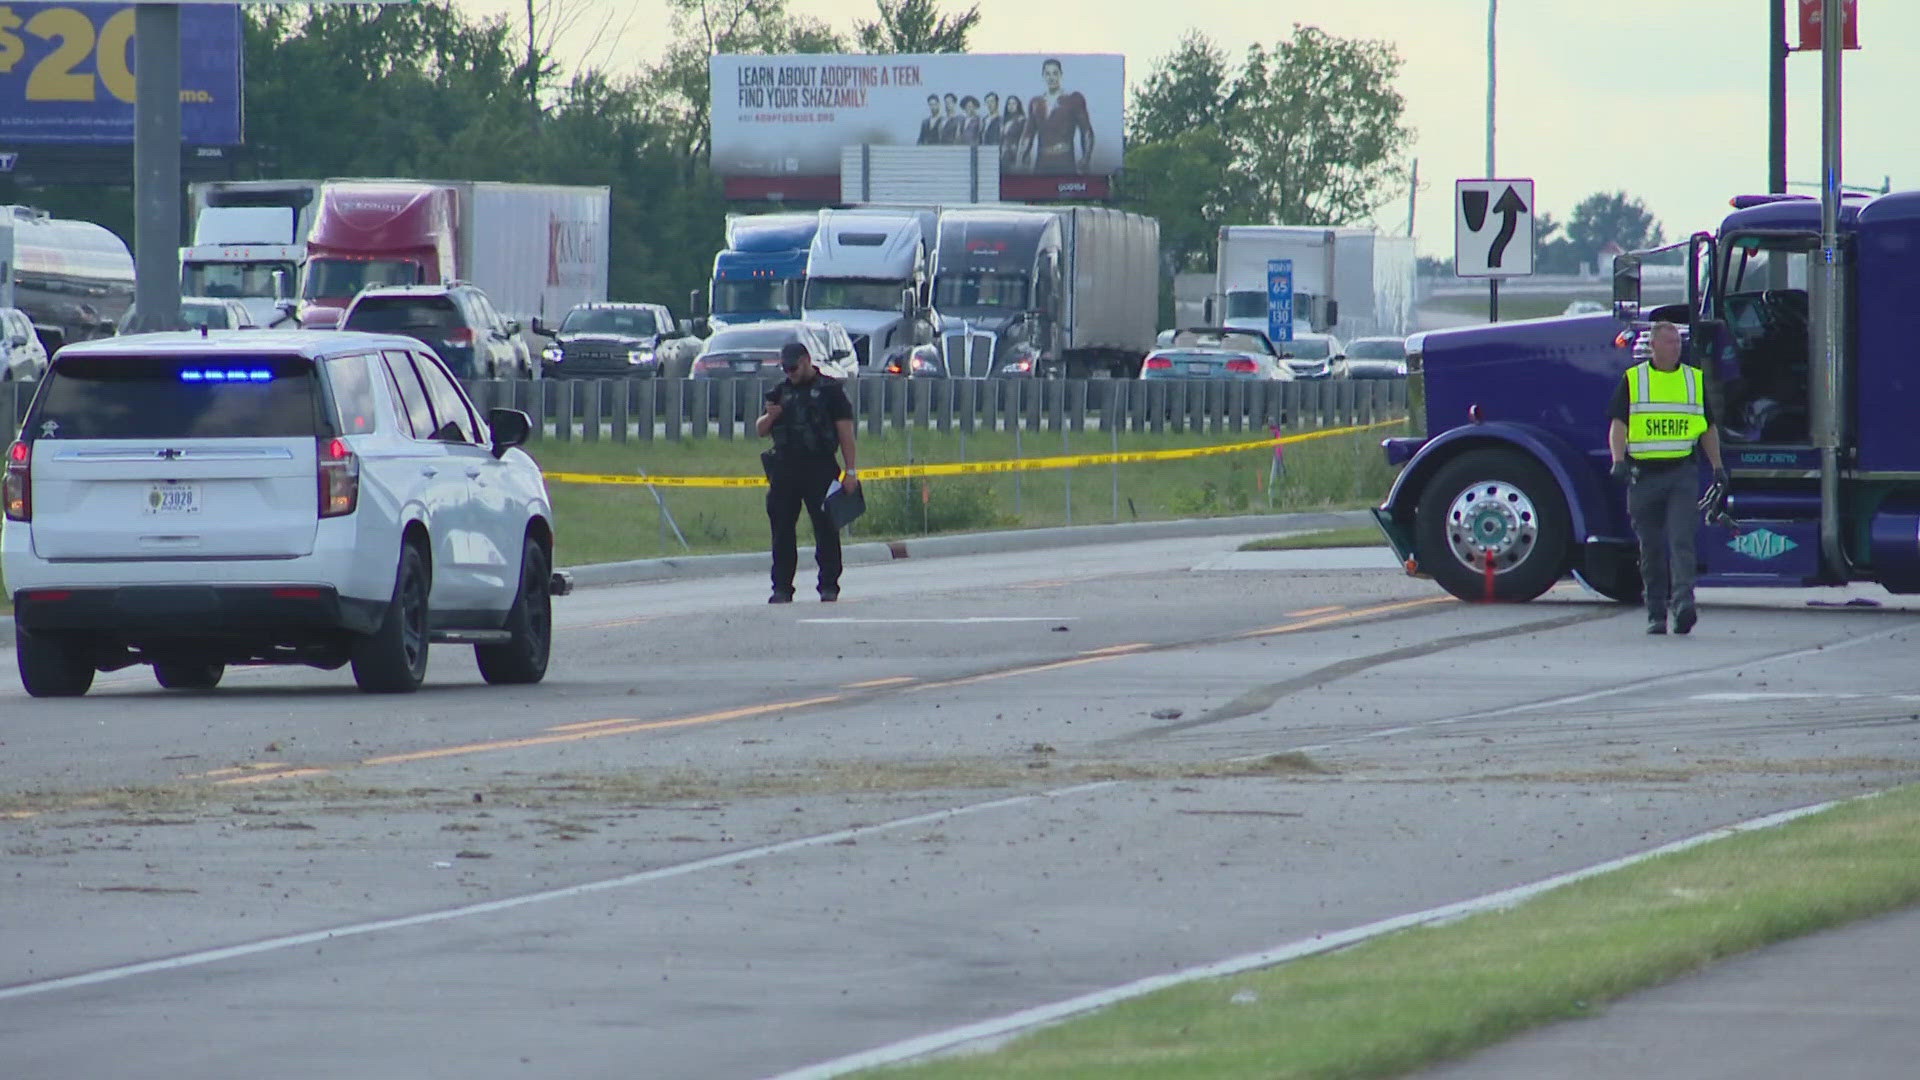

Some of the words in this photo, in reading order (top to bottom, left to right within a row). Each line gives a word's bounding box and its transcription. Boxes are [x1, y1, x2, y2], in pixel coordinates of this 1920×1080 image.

[738, 66, 774, 86] LEARN
[778, 66, 816, 86] ABOUT
[820, 66, 878, 86] ADOPTING
[881, 66, 889, 86] A
[892, 66, 923, 86] TEEN.
[738, 88, 764, 108] FIND
[767, 88, 798, 108] YOUR
[1273, 282, 1288, 294] 65
[1269, 301, 1290, 310] MILE
[1272, 310, 1288, 321] 130
[1646, 419, 1689, 436] SHERIFF
[162, 491, 192, 505] 23028
